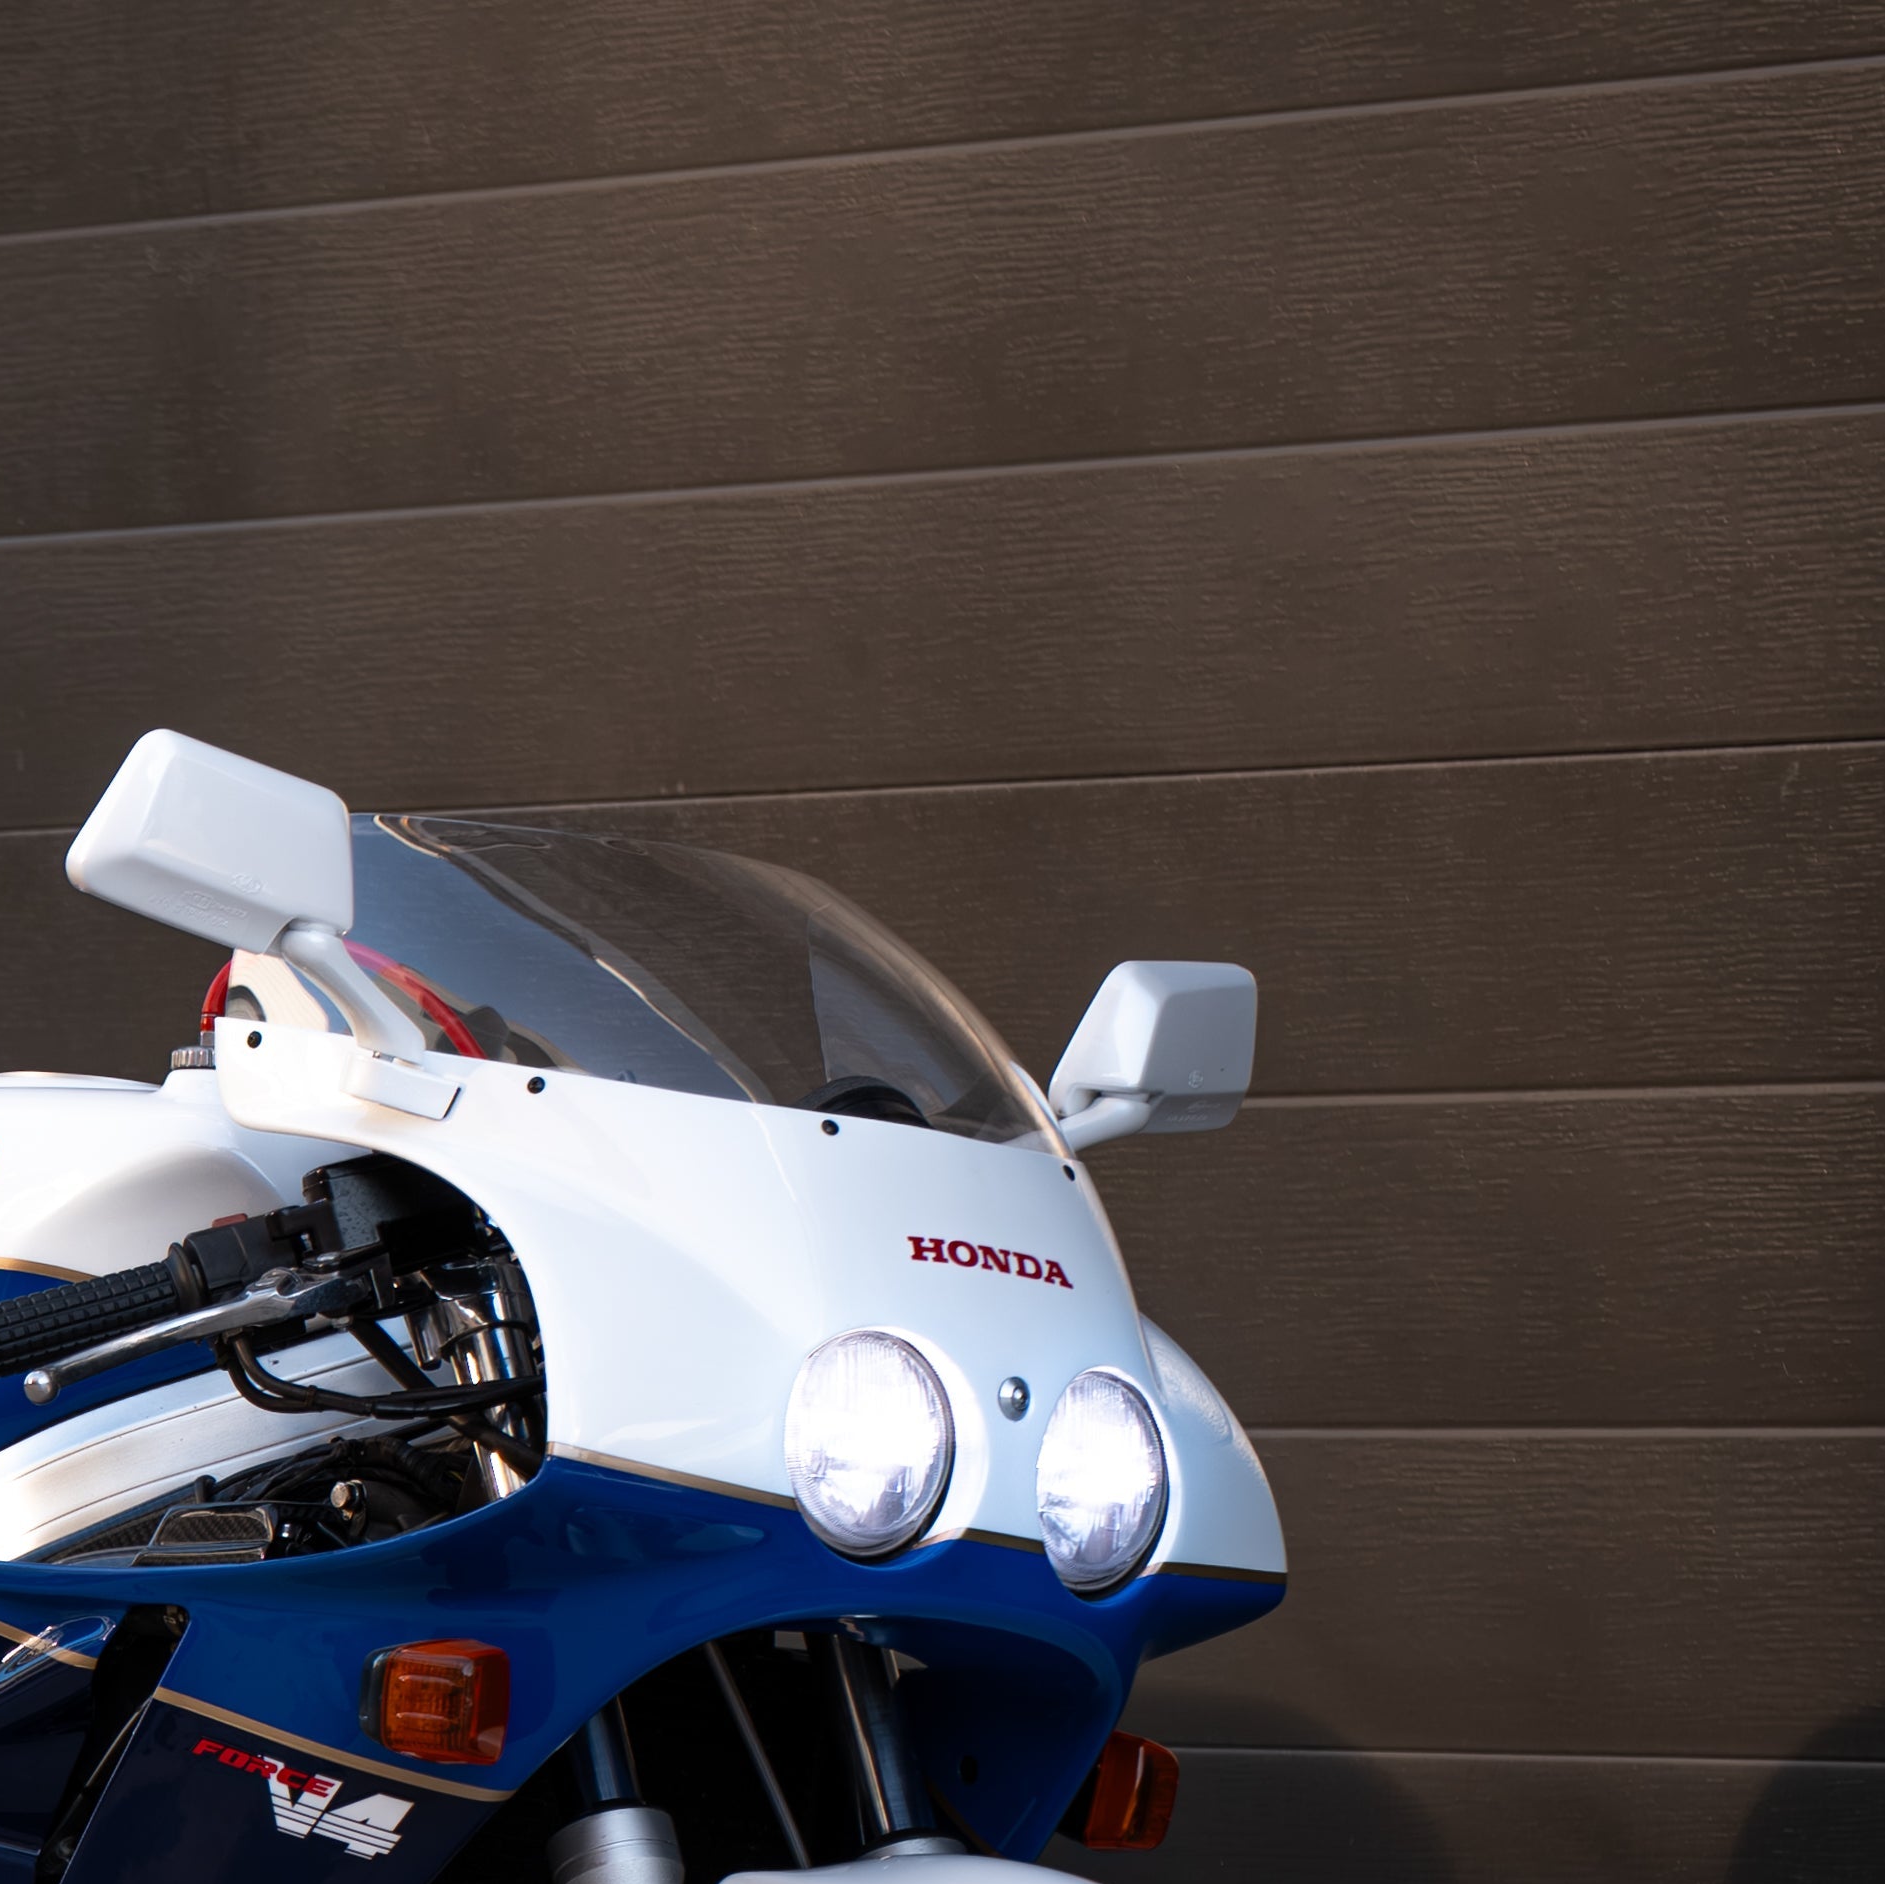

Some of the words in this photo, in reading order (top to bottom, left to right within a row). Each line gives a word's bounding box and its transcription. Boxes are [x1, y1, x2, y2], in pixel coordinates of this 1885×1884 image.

[908, 1236, 1073, 1289] HONDA
[193, 1737, 335, 1798] FORCE
[263, 1756, 415, 1861] V4
